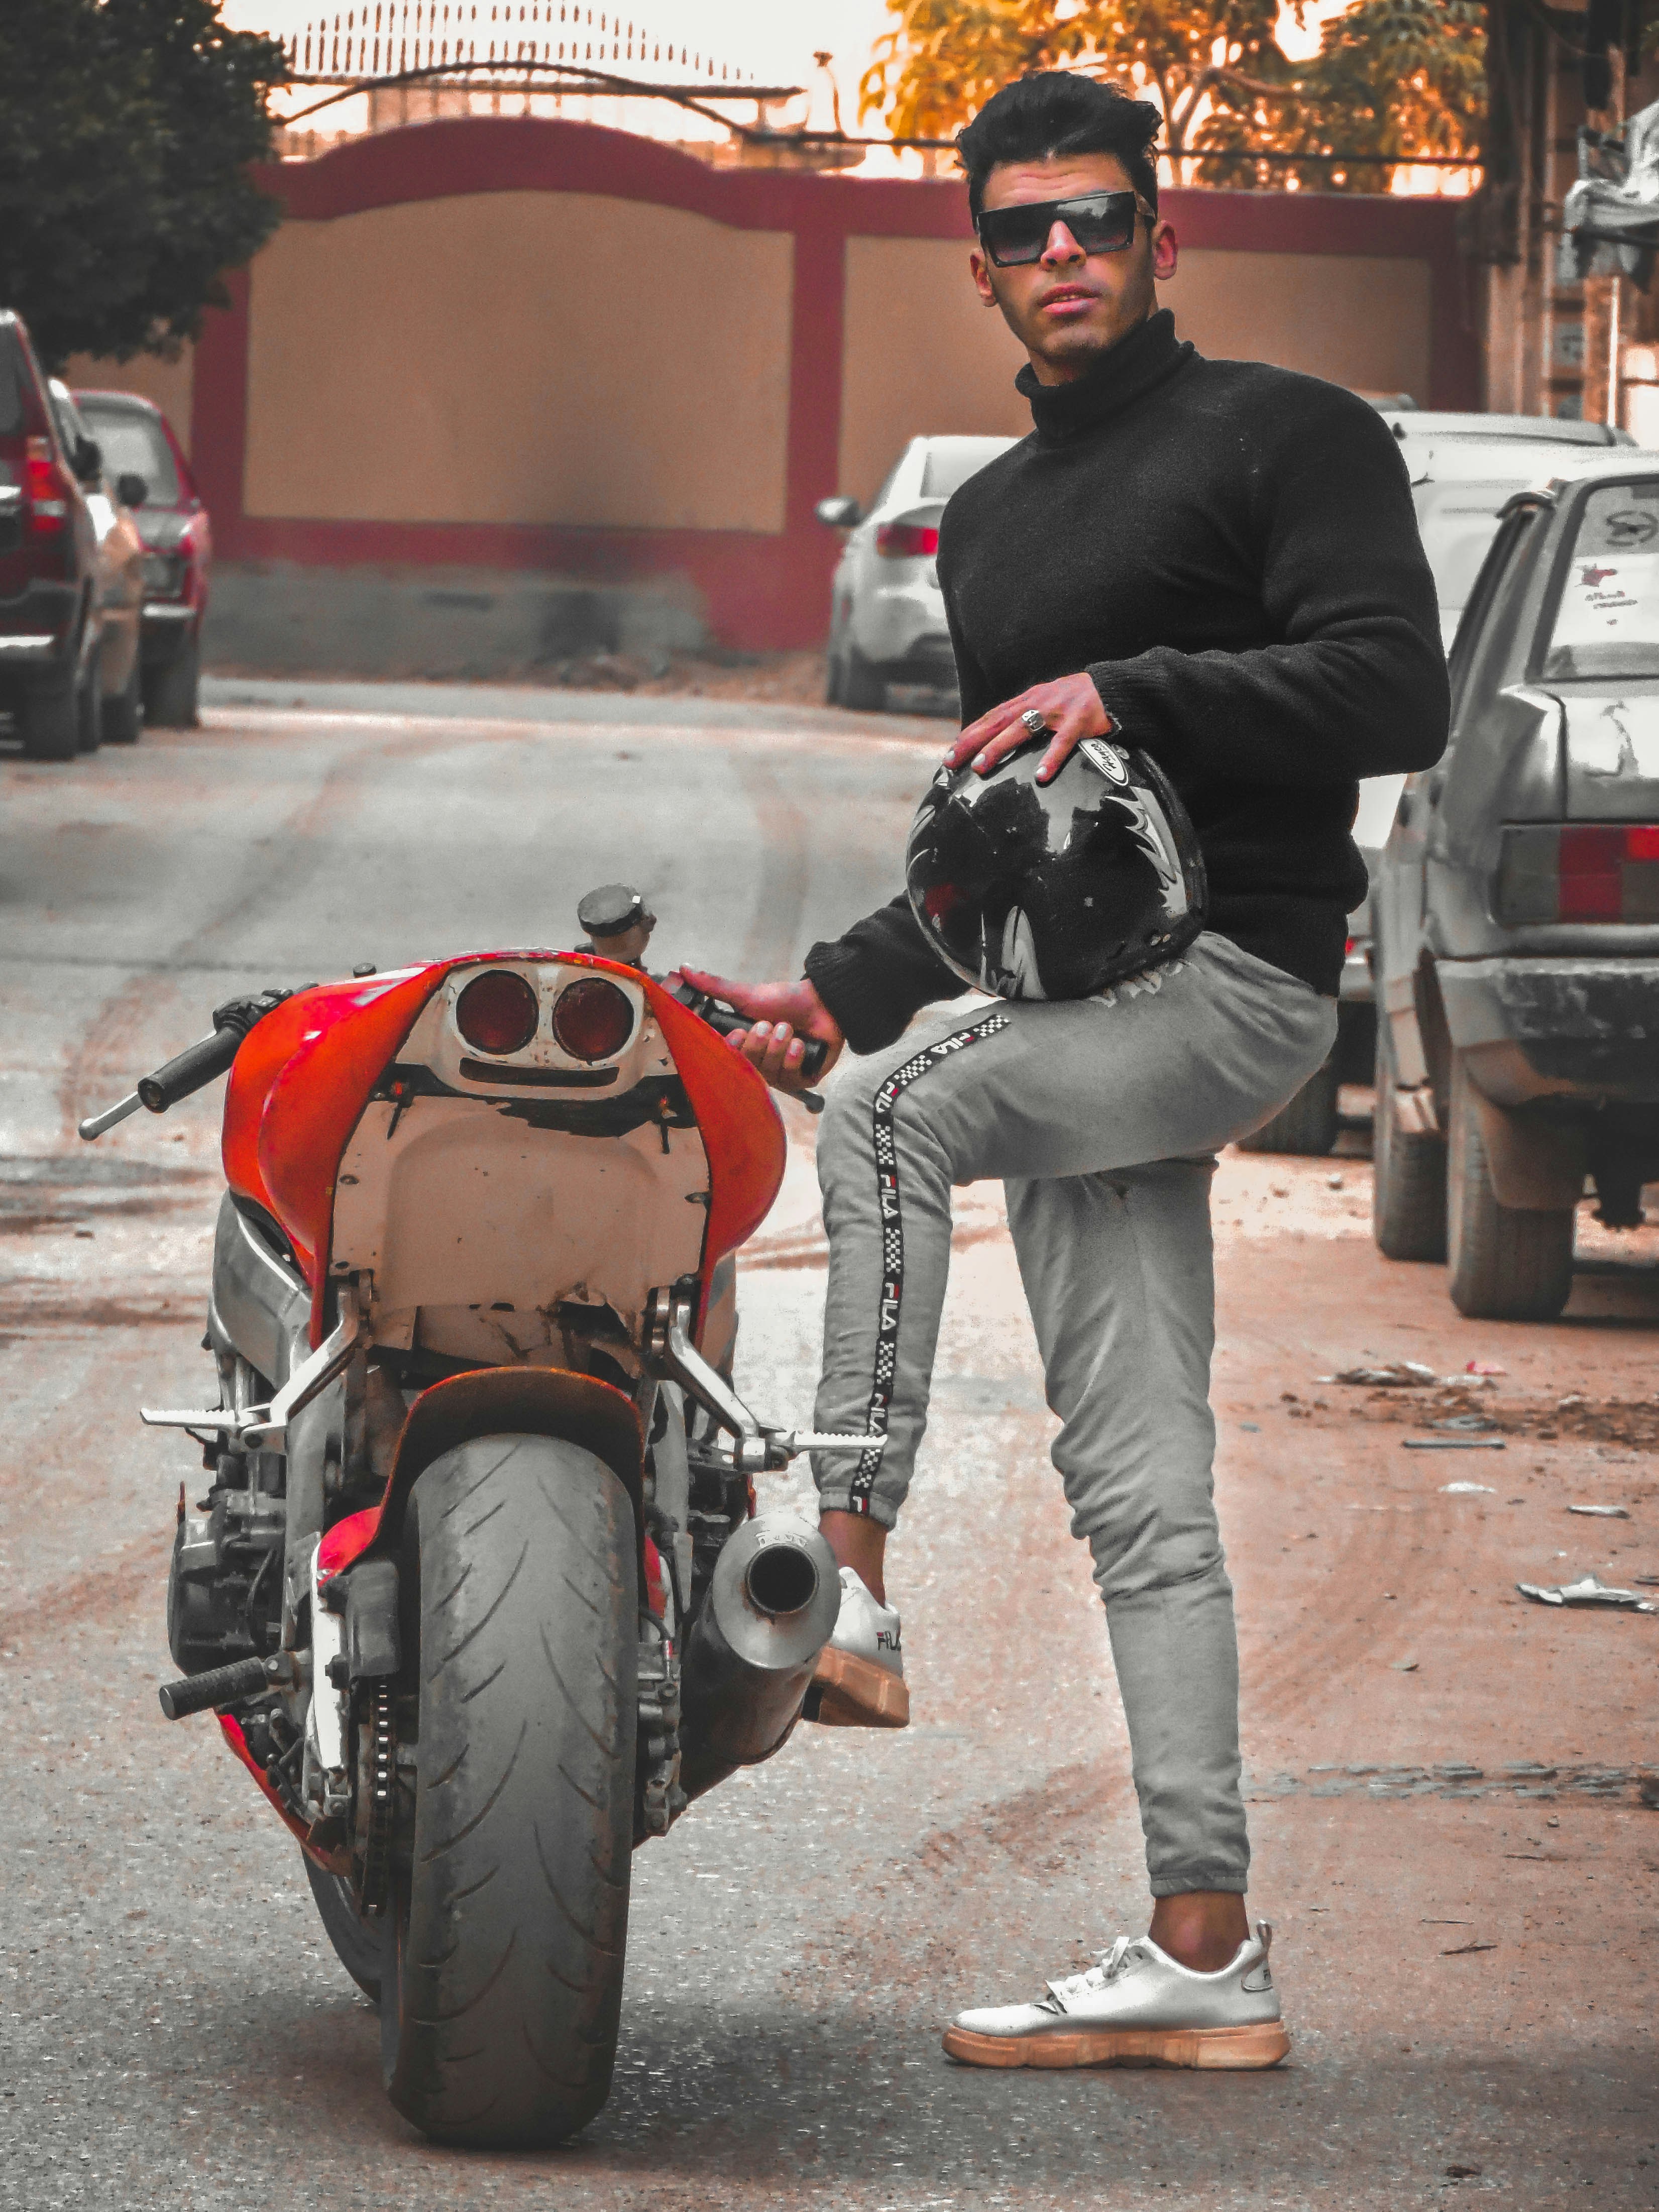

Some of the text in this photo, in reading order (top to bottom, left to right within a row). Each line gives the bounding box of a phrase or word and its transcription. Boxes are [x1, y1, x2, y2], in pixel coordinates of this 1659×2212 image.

[930, 1032, 974, 1054] FILA
[875, 1081, 899, 1113] FILA
[880, 1174, 899, 1219] FILA
[881, 1282, 900, 1330] FILA
[869, 1393, 888, 1436] FILA
